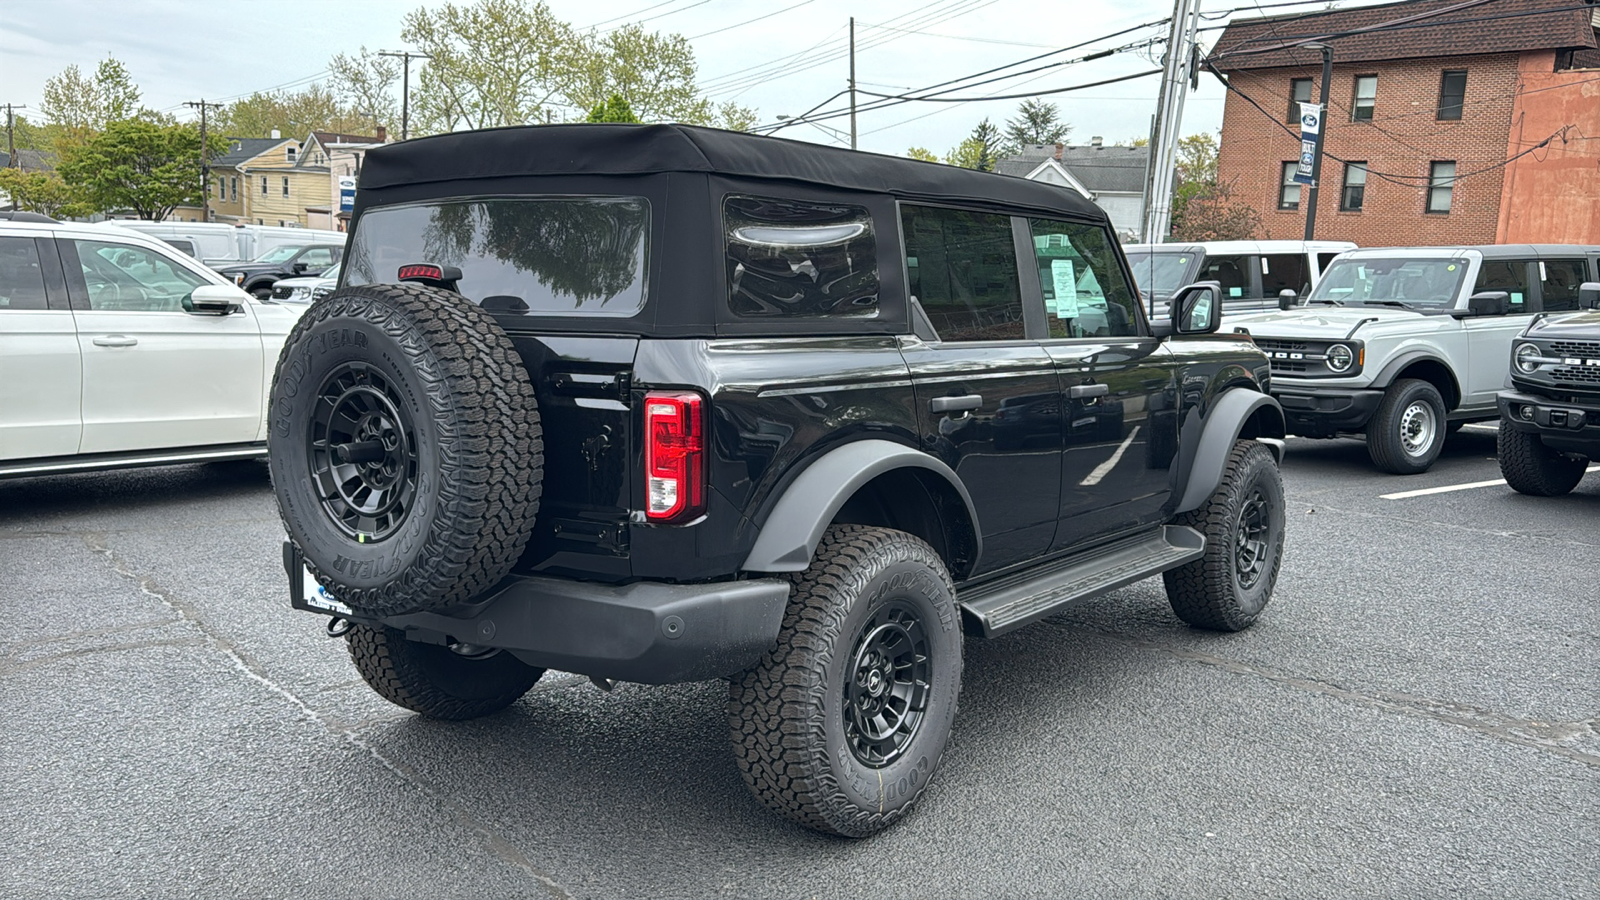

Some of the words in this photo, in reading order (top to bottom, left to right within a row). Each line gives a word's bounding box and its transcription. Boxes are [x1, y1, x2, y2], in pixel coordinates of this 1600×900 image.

[1303, 115, 1317, 126] Ford
[276, 329, 368, 438] GOODYEAR
[332, 471, 431, 580] GOODYEAR
[867, 569, 953, 633] GOODYEAR
[837, 743, 928, 808] GOODYEAR
